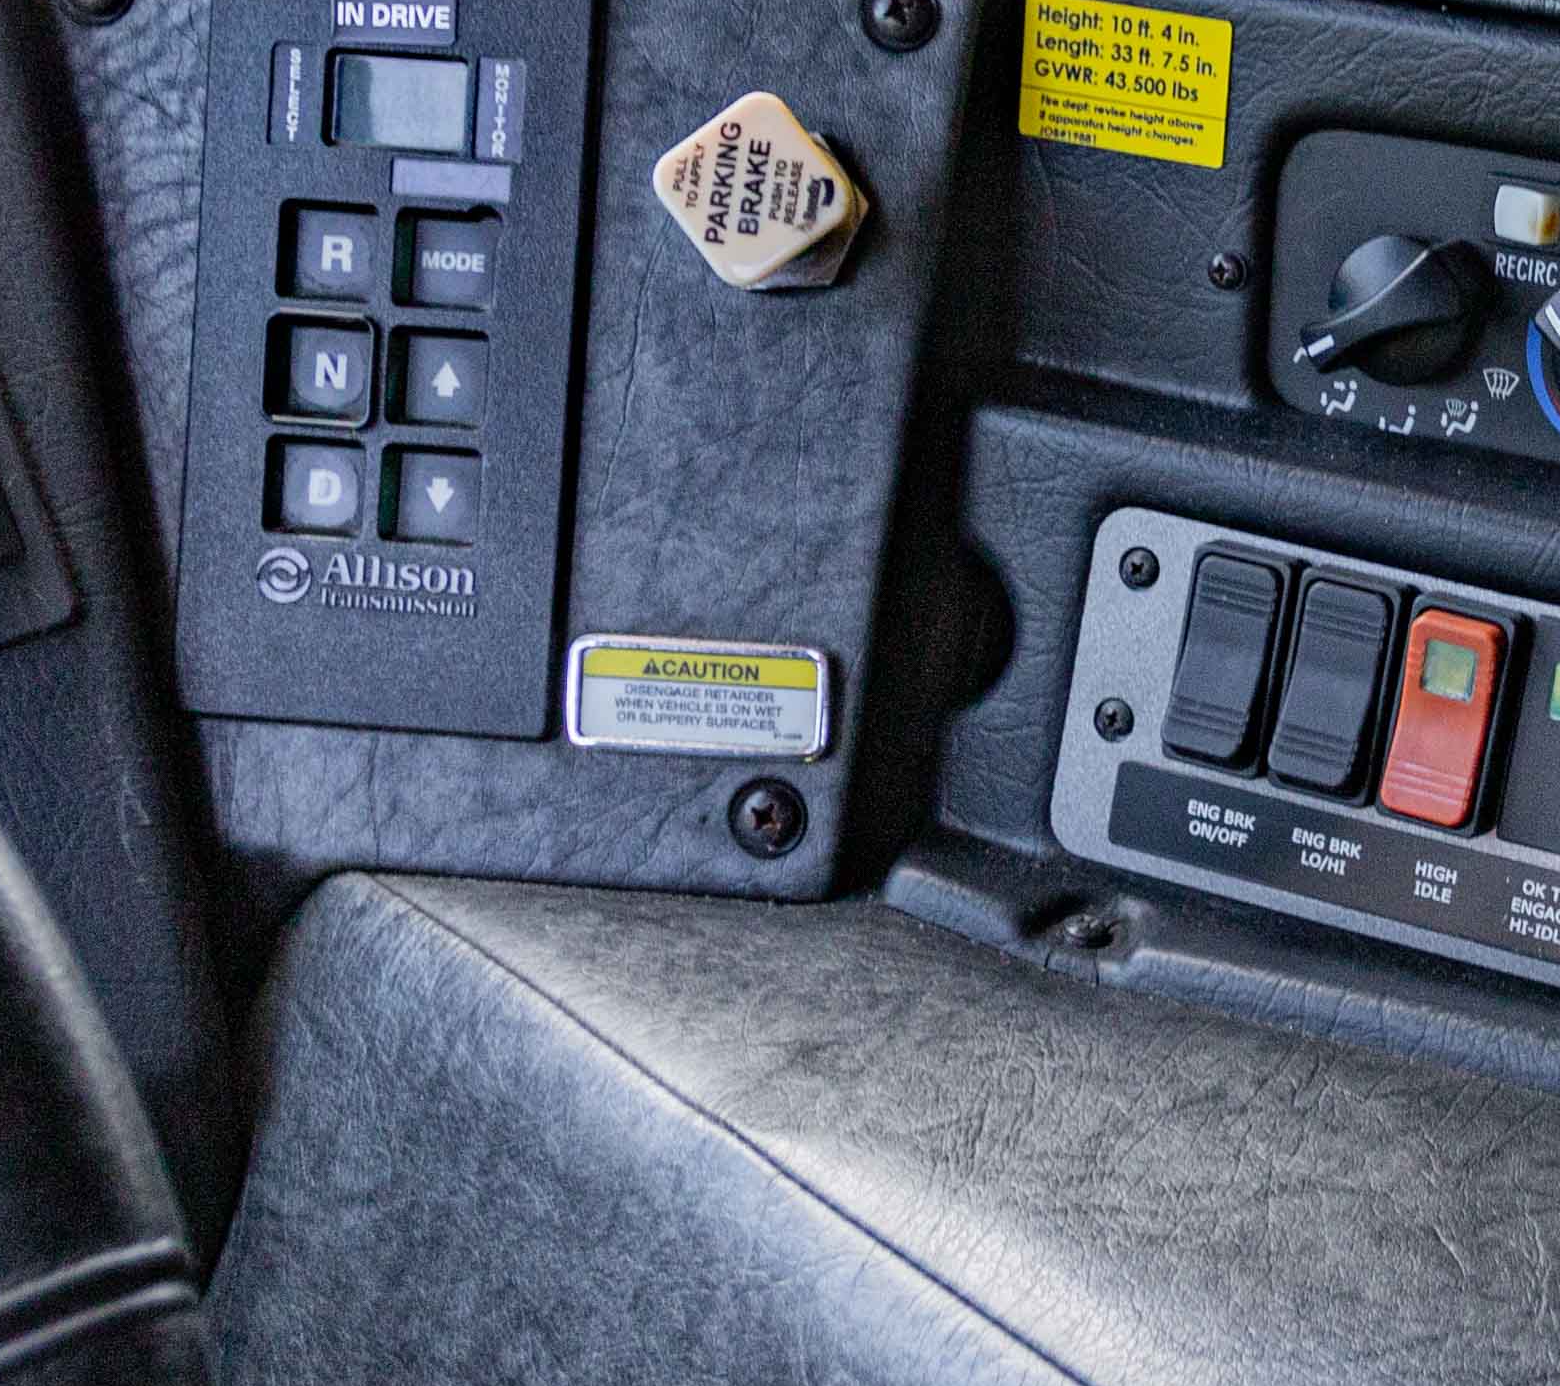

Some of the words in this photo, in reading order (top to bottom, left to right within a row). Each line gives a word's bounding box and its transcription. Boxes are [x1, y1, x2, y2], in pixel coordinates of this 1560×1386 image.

[336, 1, 365, 27] IN
[371, 2, 451, 30] DRIVE
[1037, 4, 1104, 32] Height:
[1112, 16, 1133, 35] 10
[1138, 20, 1155, 40] ft.
[1161, 24, 1172, 41] 4
[1178, 25, 1200, 46] in.
[1035, 31, 1104, 59] Length:
[1111, 43, 1133, 63] 33
[1139, 47, 1155, 68] ft.
[1162, 51, 1189, 73] 7.5
[1196, 56, 1217, 78] in.
[285, 47, 302, 142] SELECT
[1034, 58, 1098, 86] GVWR:
[1172, 81, 1199, 102] lbs
[491, 62, 511, 159] MONITOR
[1048, 113, 1104, 132] apparatus
[1107, 120, 1143, 138] height
[1094, 104, 1126, 118] revise
[1130, 106, 1165, 126] height
[1168, 115, 1204, 132] above
[672, 156, 689, 193] PULL
[689, 141, 705, 189] APPLY
[774, 159, 789, 179] TO
[685, 190, 699, 209] TO
[703, 121, 743, 246] PARKING
[737, 137, 772, 237] BRAKE
[783, 159, 804, 227] RELEASE
[768, 182, 785, 221] PUSH
[320, 234, 354, 273] R
[420, 249, 486, 274] MODE
[1493, 251, 1560, 288] RECIRC
[313, 350, 348, 390] N
[307, 467, 341, 506] D
[320, 552, 476, 596] Allison
[319, 585, 478, 619] Transmission
[661, 658, 760, 682] CAUTION
[615, 696, 654, 711] WHEN
[657, 699, 712, 714] VEHICLE
[715, 703, 728, 714] IS
[731, 704, 753, 715] ON
[754, 705, 783, 717] WET
[624, 682, 699, 699] DISENGAGE
[704, 687, 776, 703] RETARDER
[616, 711, 636, 724] OR
[639, 713, 703, 728] SLIPPERY
[1187, 798, 1222, 823] ENG
[1223, 807, 1258, 832] BRK
[1188, 819, 1250, 849] ON/OFF
[1291, 826, 1326, 851] ENG
[1329, 835, 1363, 860] BRK
[1299, 849, 1348, 876] LO/HI
[1414, 859, 1459, 886] HIGH
[1413, 879, 1453, 905] IDLE
[1521, 878, 1546, 900] OK
